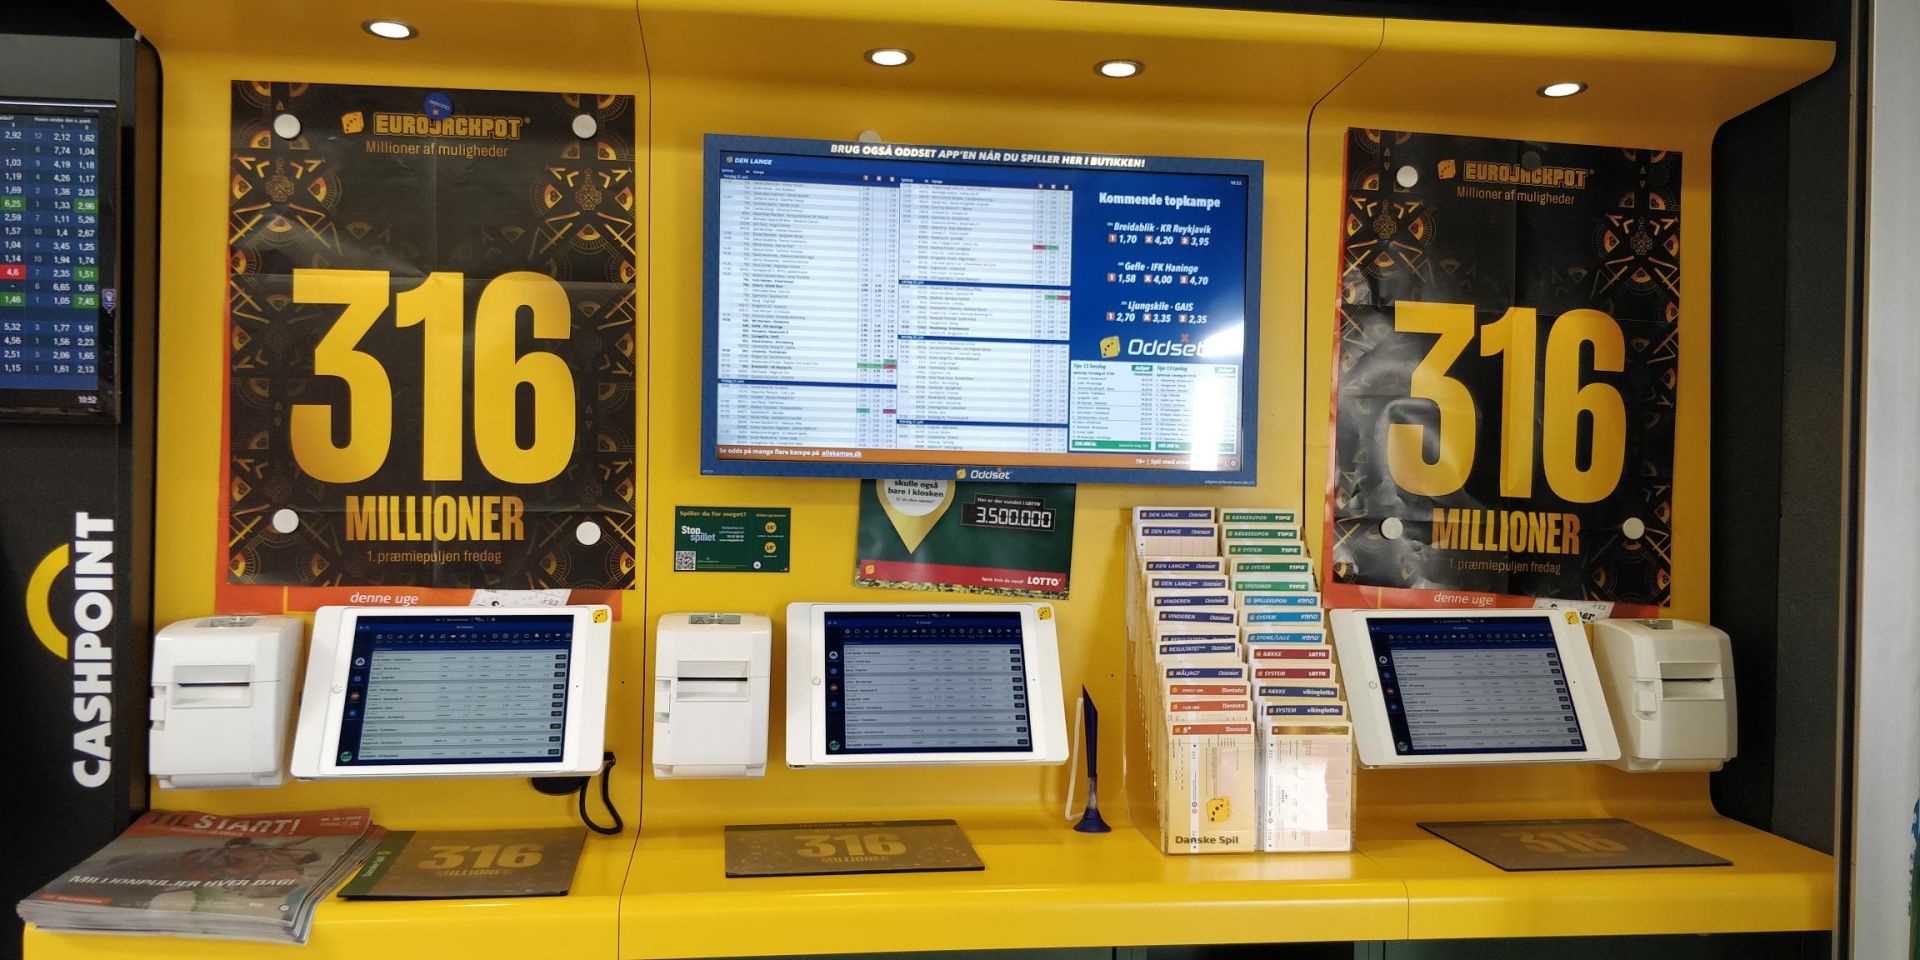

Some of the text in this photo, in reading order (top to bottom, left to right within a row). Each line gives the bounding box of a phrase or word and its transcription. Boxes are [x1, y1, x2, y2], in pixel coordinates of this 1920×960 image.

[366, 142, 509, 161] Millioner af muligheder
[830, 143, 860, 155] BRUG
[862, 143, 892, 157] OGSÅ
[894, 146, 937, 159] ODDSET
[938, 148, 976, 160] APP'EN
[978, 148, 1001, 162] NÅR
[1003, 151, 1019, 162] DU
[1020, 152, 1060, 164] SPILLER
[1062, 156, 1083, 166] HER
[1090, 157, 1146, 168] BUTIKKEN!
[734, 156, 773, 166] DEN LANGE
[1464, 160, 1589, 189] EUROJACKPOT
[1099, 192, 1221, 211] Kommende topkampe
[1456, 185, 1576, 206] Millioner af muligheder
[1113, 222, 1211, 236] Breidablik KR Reykjavik
[1119, 235, 1210, 246] 1,70 4,20 3,95
[1124, 262, 1199, 273] Gefle IFK Haninge
[1118, 274, 1209, 285] 1,58 4,00 4,70
[1128, 301, 1194, 312] Ljungskile GAIS
[1116, 313, 1208, 324] 2,70 3,35 2,35
[289, 268, 577, 485] 316
[1386, 300, 1628, 504] 316
[728, 446, 743, 454] odds
[790, 448, 811, 458] kampe
[970, 468, 1012, 480] Oddset
[888, 486, 906, 495] bare
[912, 488, 944, 498] kiosken
[920, 480, 939, 490] også
[345, 494, 525, 543] MILLIONER
[976, 506, 1052, 528] 3.500.000
[1431, 507, 1580, 556] MILLIONER
[377, 549, 461, 567] præmiepuljen
[463, 549, 503, 566] fredag
[1457, 558, 1529, 576] præmiepuljen
[1530, 560, 1562, 576] fredag
[1027, 576, 1060, 587] LOTTO
[350, 591, 420, 609] denne uge
[1433, 592, 1494, 608] denne uge
[72, 511, 115, 788] CASHPOINT
[795, 833, 906, 858] 316
[1175, 835, 1239, 846] Danske Spil
[417, 843, 544, 870] 316
